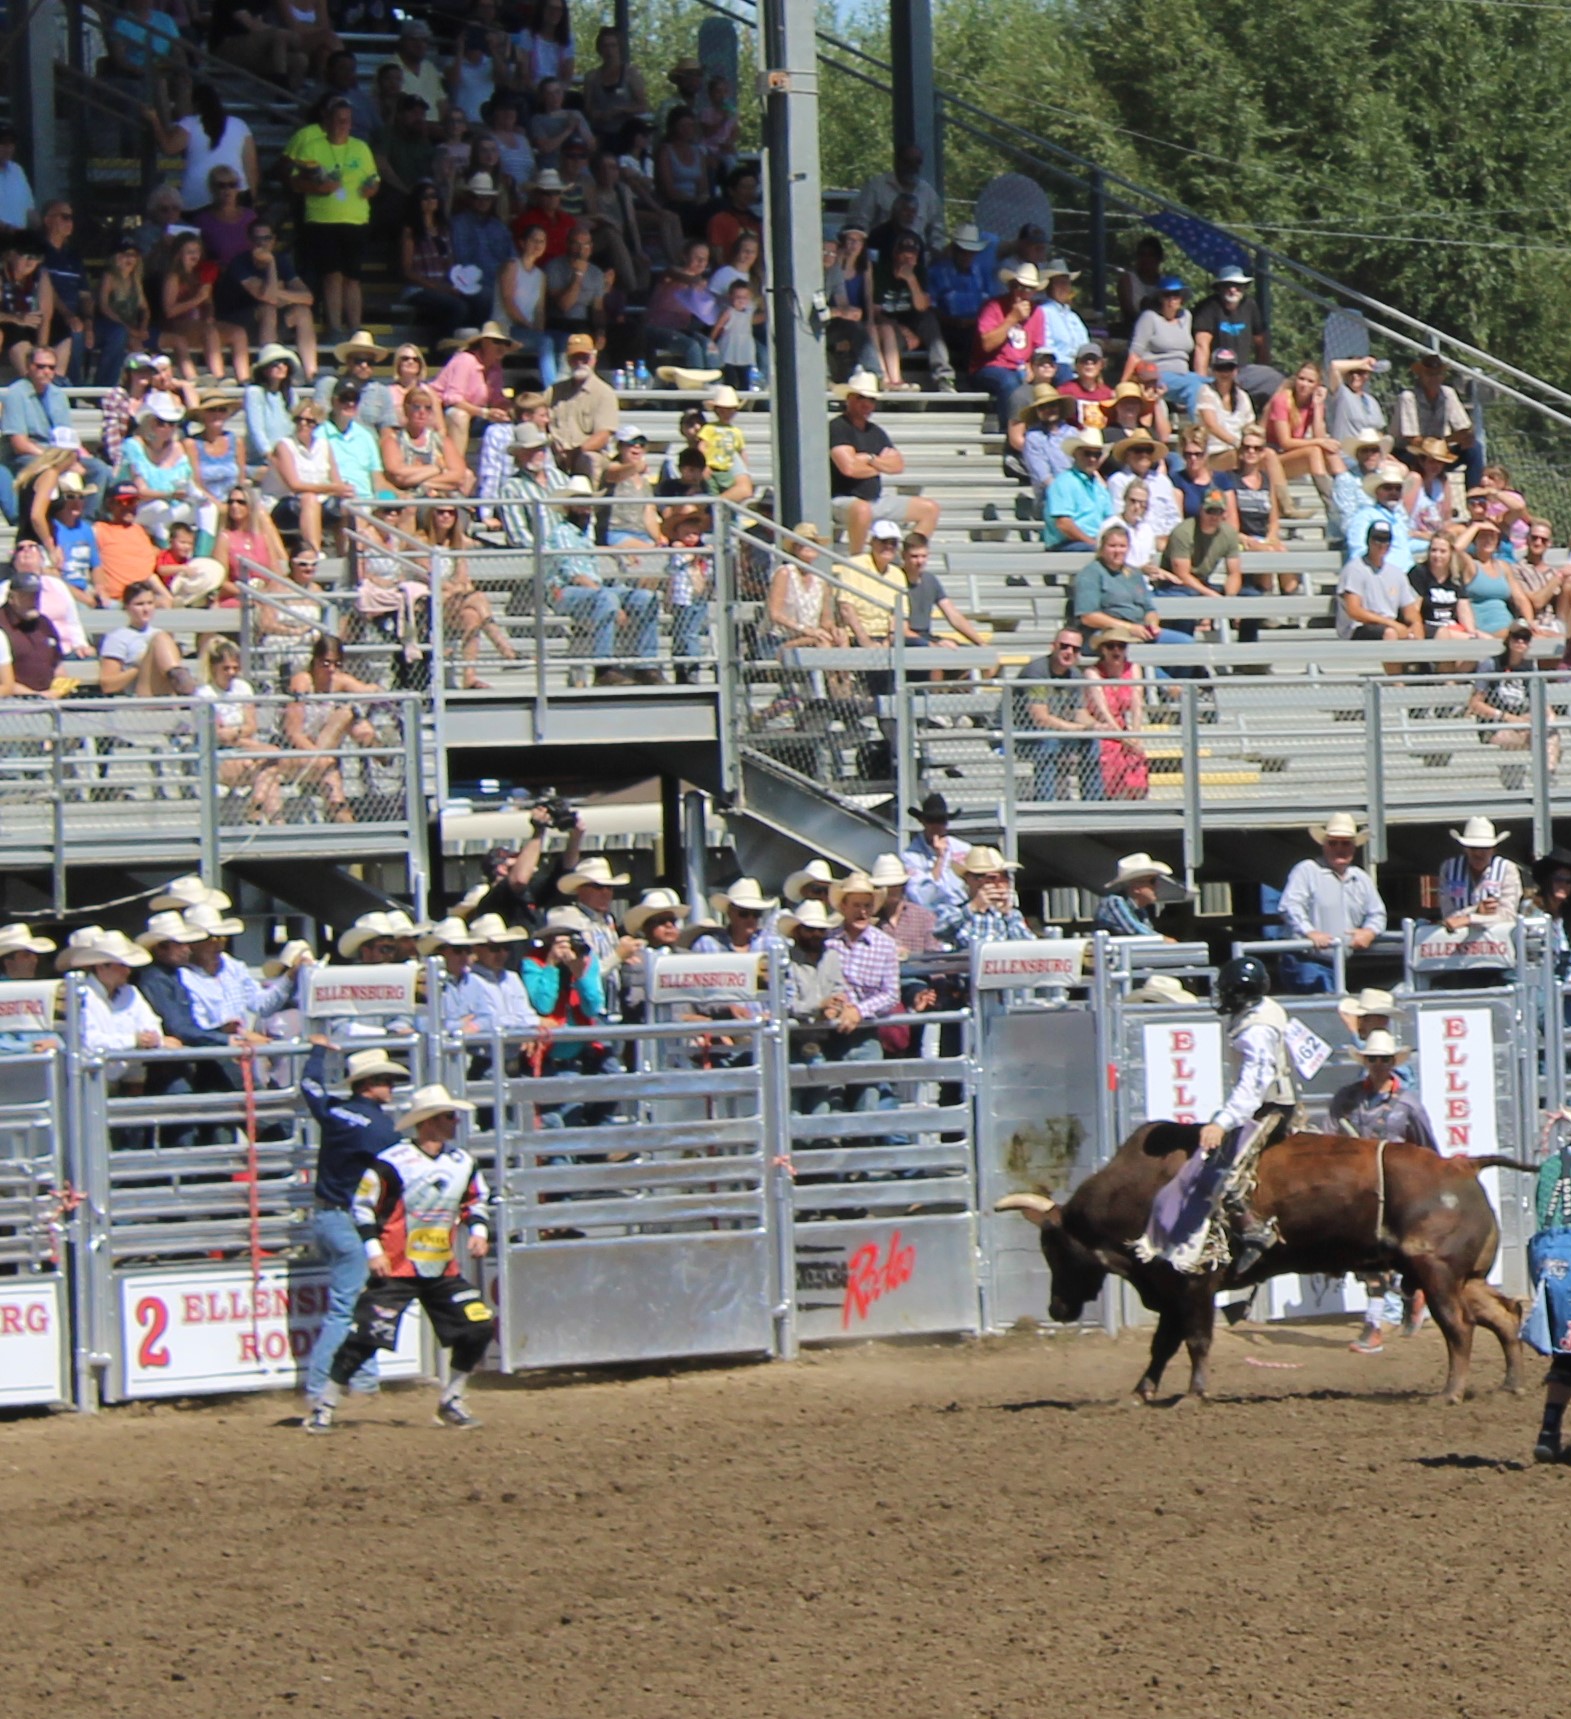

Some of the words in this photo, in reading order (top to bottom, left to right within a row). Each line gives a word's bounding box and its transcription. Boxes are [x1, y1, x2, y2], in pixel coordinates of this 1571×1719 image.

[1420, 941, 1508, 958] ELLENSBURG
[983, 957, 1074, 976] ELLENSBURG
[658, 972, 748, 989] ELLENSBURG
[315, 984, 406, 1002] ELLENSBURG
[1299, 1035, 1321, 1059] 62
[136, 1296, 171, 1369] 2
[238, 1328, 322, 1362] ROD
